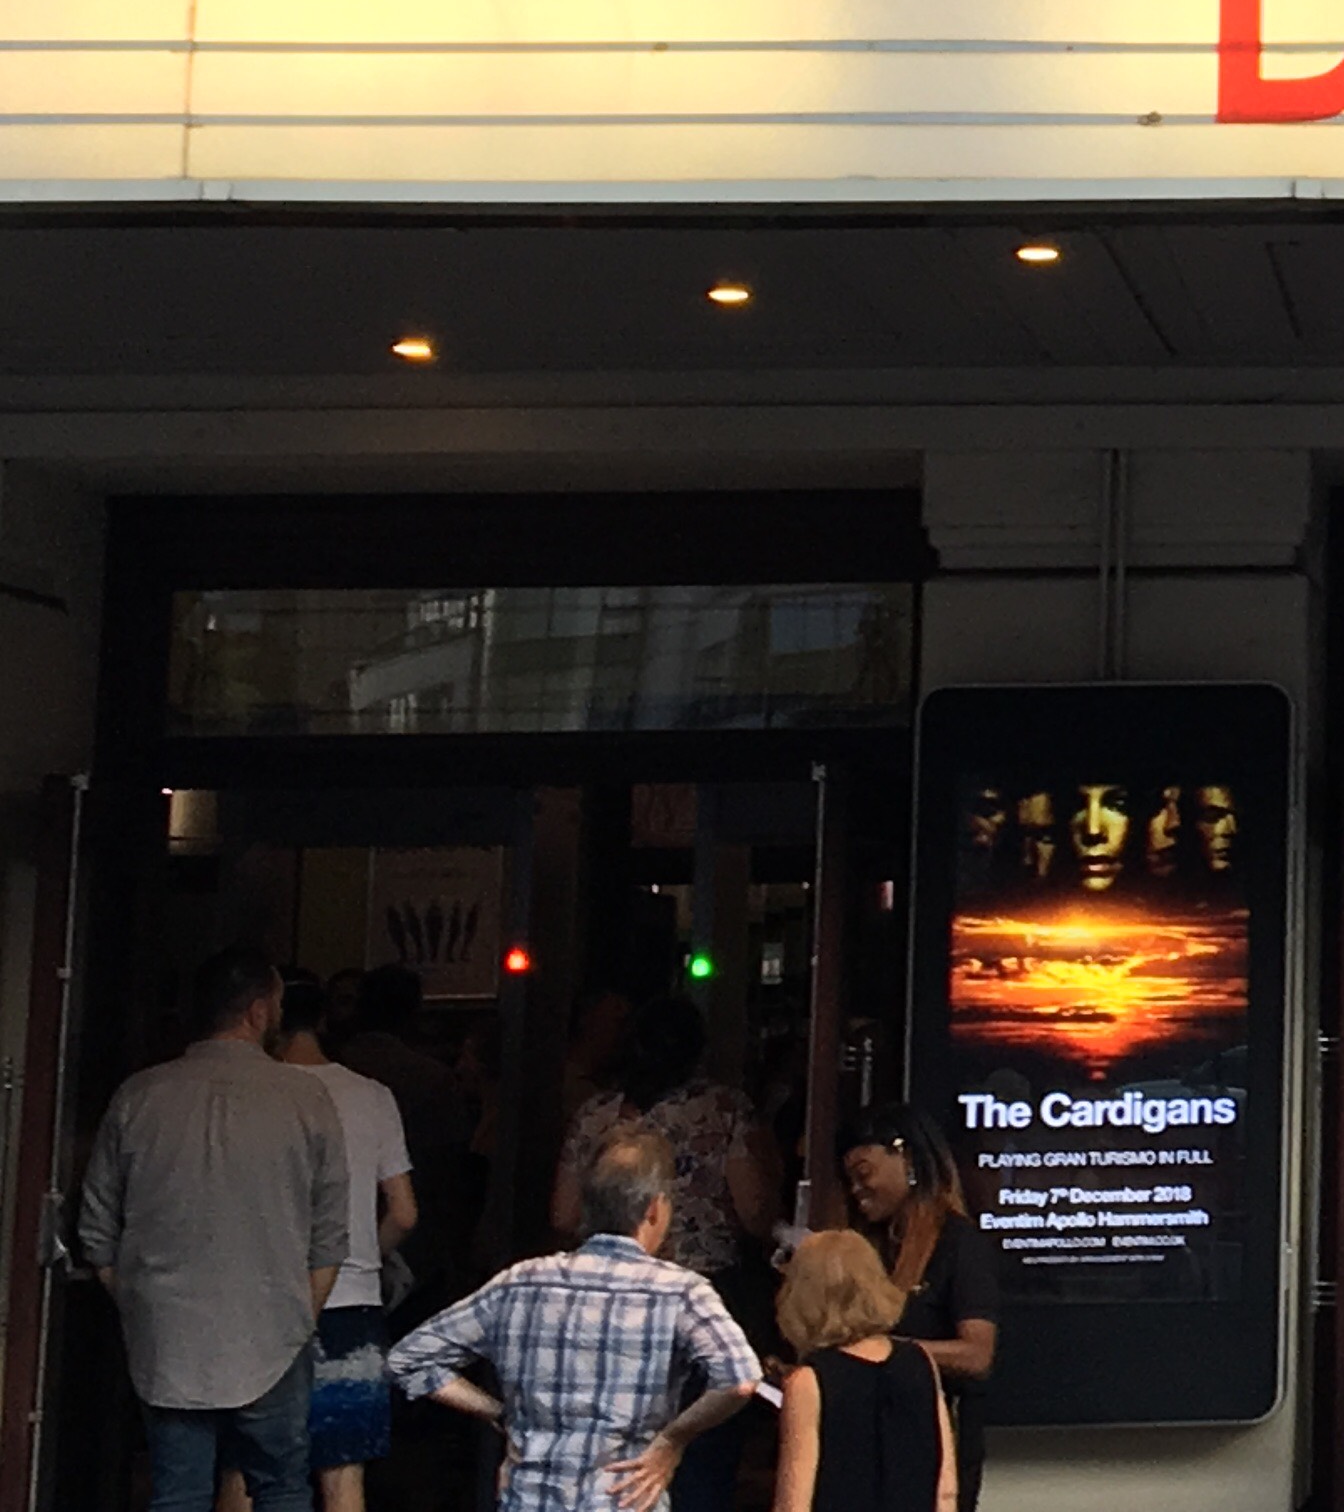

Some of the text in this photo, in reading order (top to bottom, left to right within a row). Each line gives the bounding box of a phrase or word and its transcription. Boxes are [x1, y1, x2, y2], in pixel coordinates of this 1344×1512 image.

[958, 1091, 1236, 1133] The Cardigans
[978, 1149, 1214, 1168] PLAYING GRAN TURISMO IN FULL
[999, 1189, 1049, 1207] Friday
[1069, 1186, 1152, 1204] December
[980, 1209, 1210, 1231] Eventim Apollo Hammersmith
